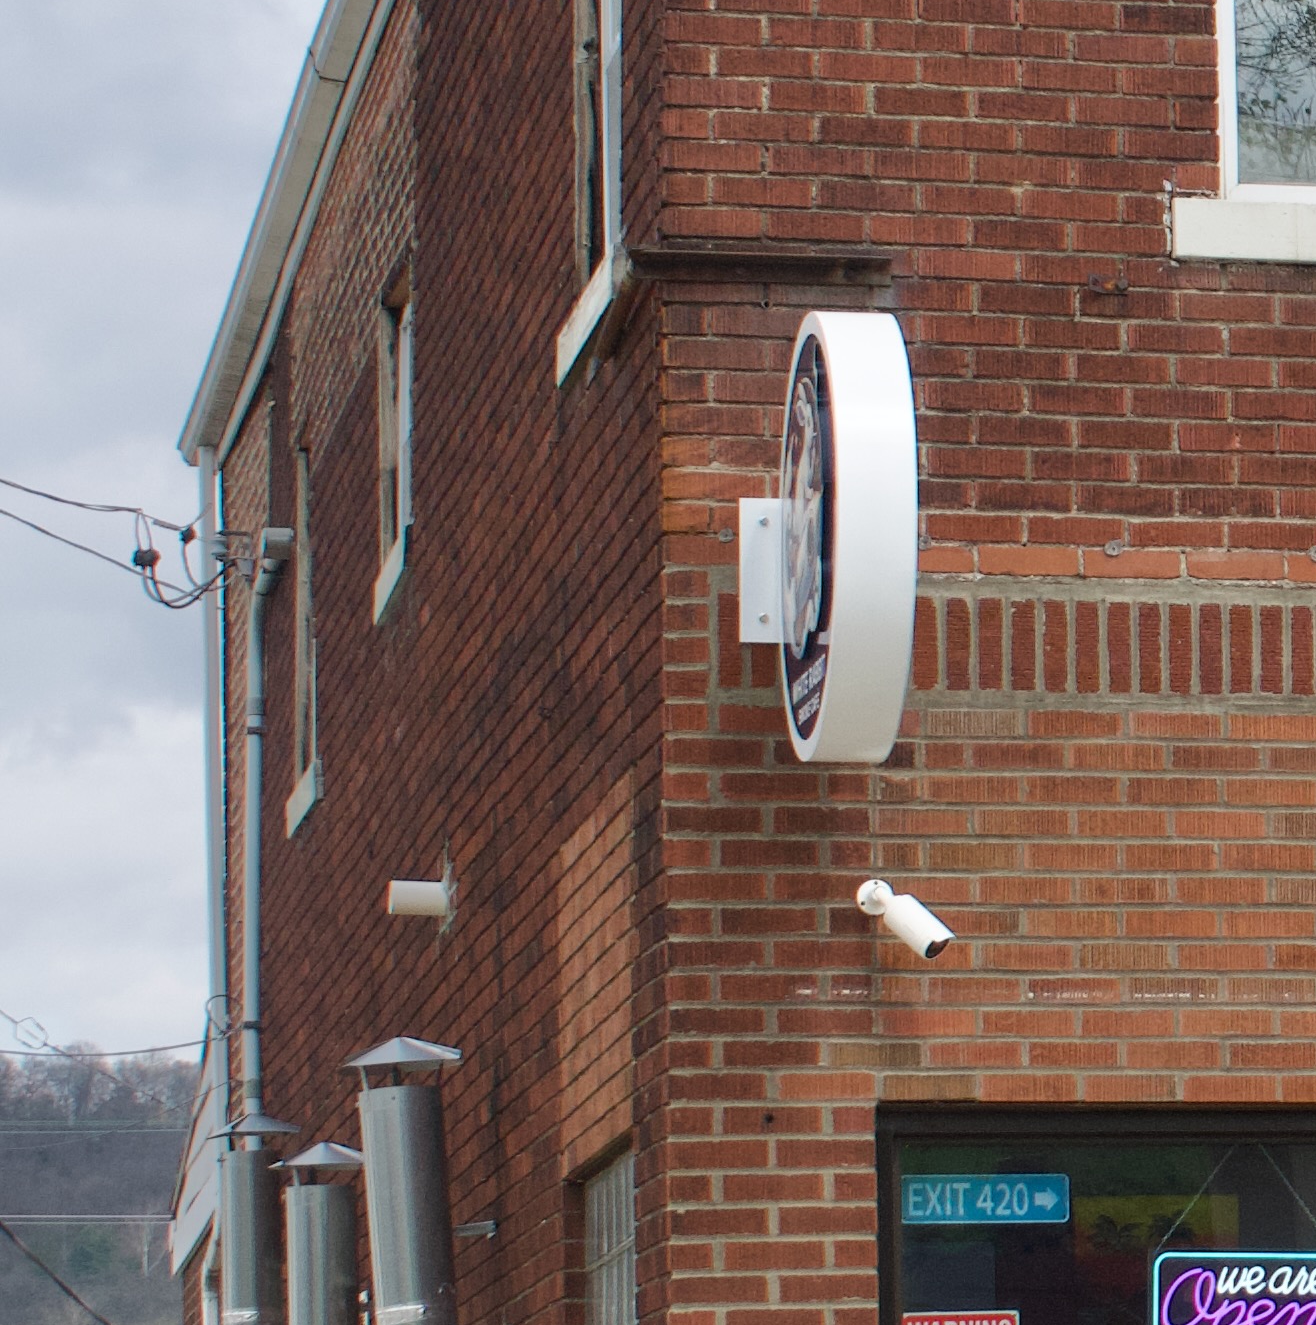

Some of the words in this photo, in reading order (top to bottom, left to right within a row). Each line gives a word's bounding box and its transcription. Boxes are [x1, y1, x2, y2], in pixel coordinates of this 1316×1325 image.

[908, 1182, 971, 1216] EXIT
[976, 1182, 1030, 1217] 420
[1216, 1265, 1267, 1295] we
